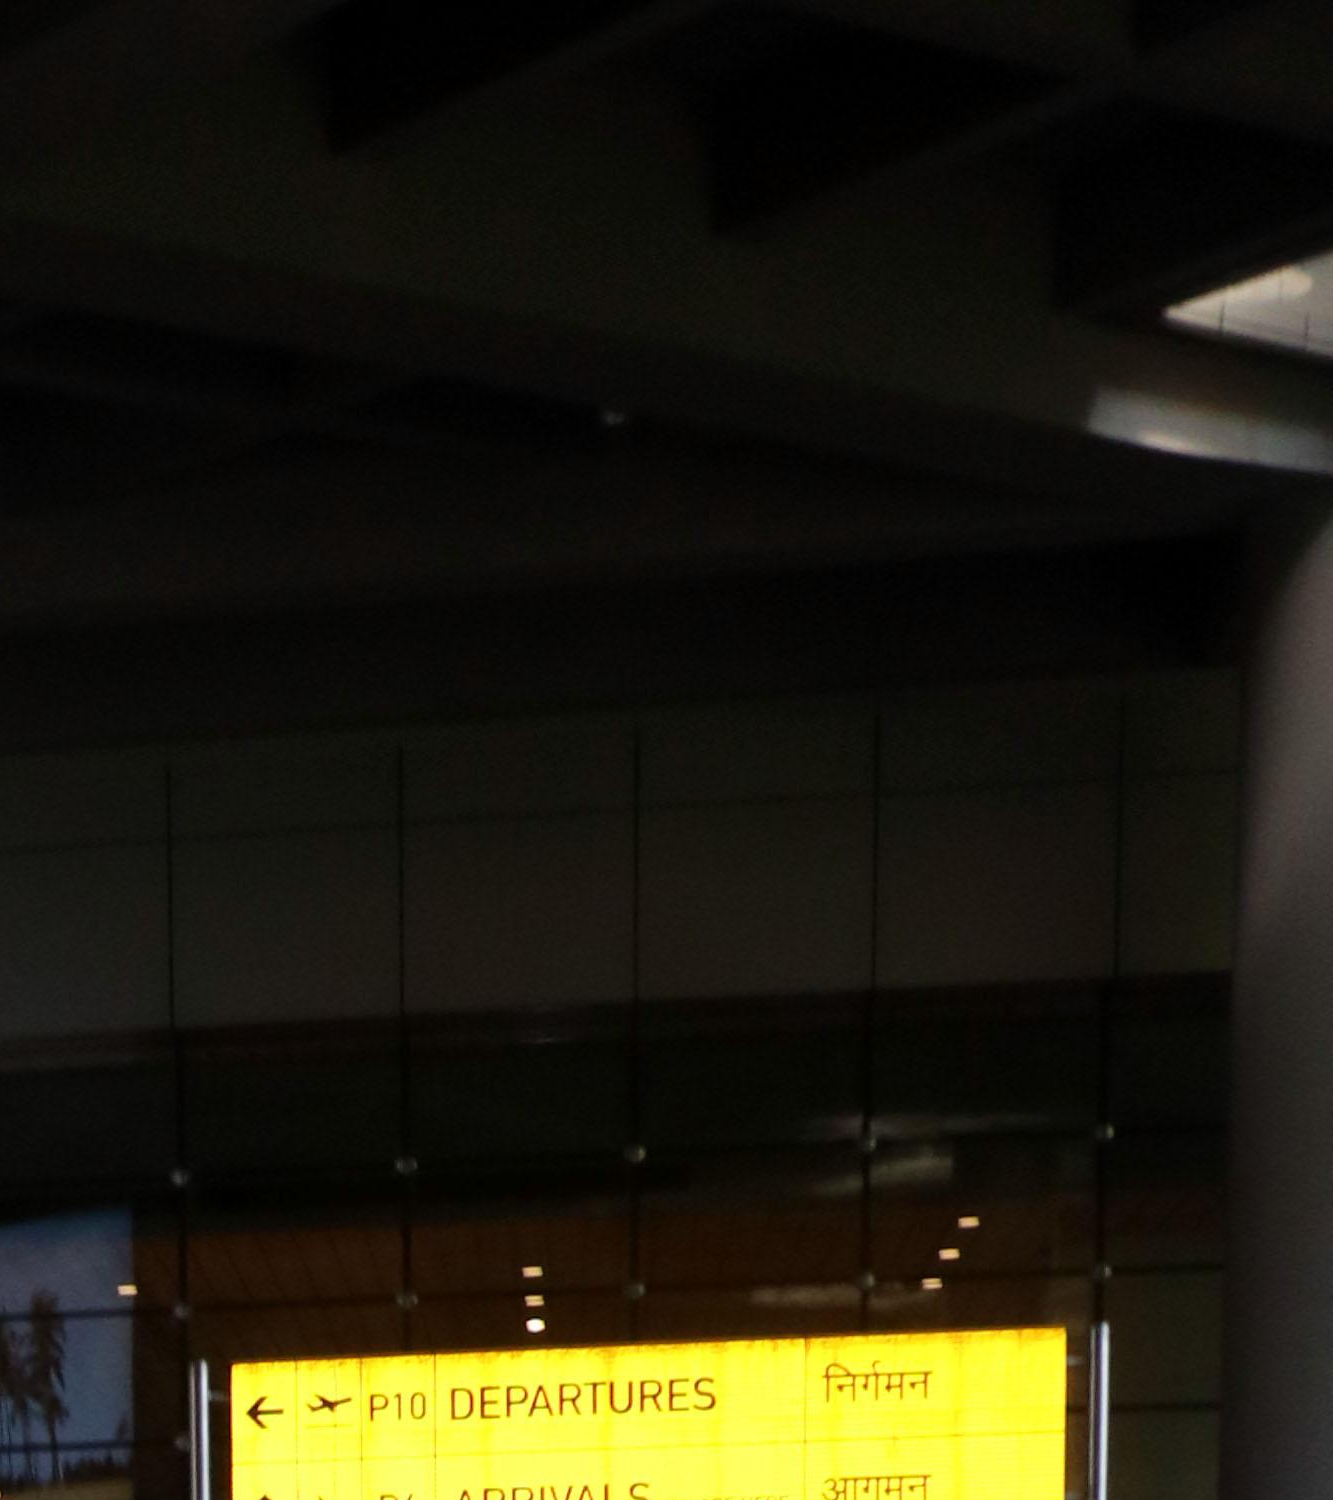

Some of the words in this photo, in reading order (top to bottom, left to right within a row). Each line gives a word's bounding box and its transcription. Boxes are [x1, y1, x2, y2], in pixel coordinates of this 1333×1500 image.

[369, 1391, 428, 1422] P10
[449, 1376, 718, 1422] DEPARTURES
[822, 1359, 934, 1404] निर्गमन
